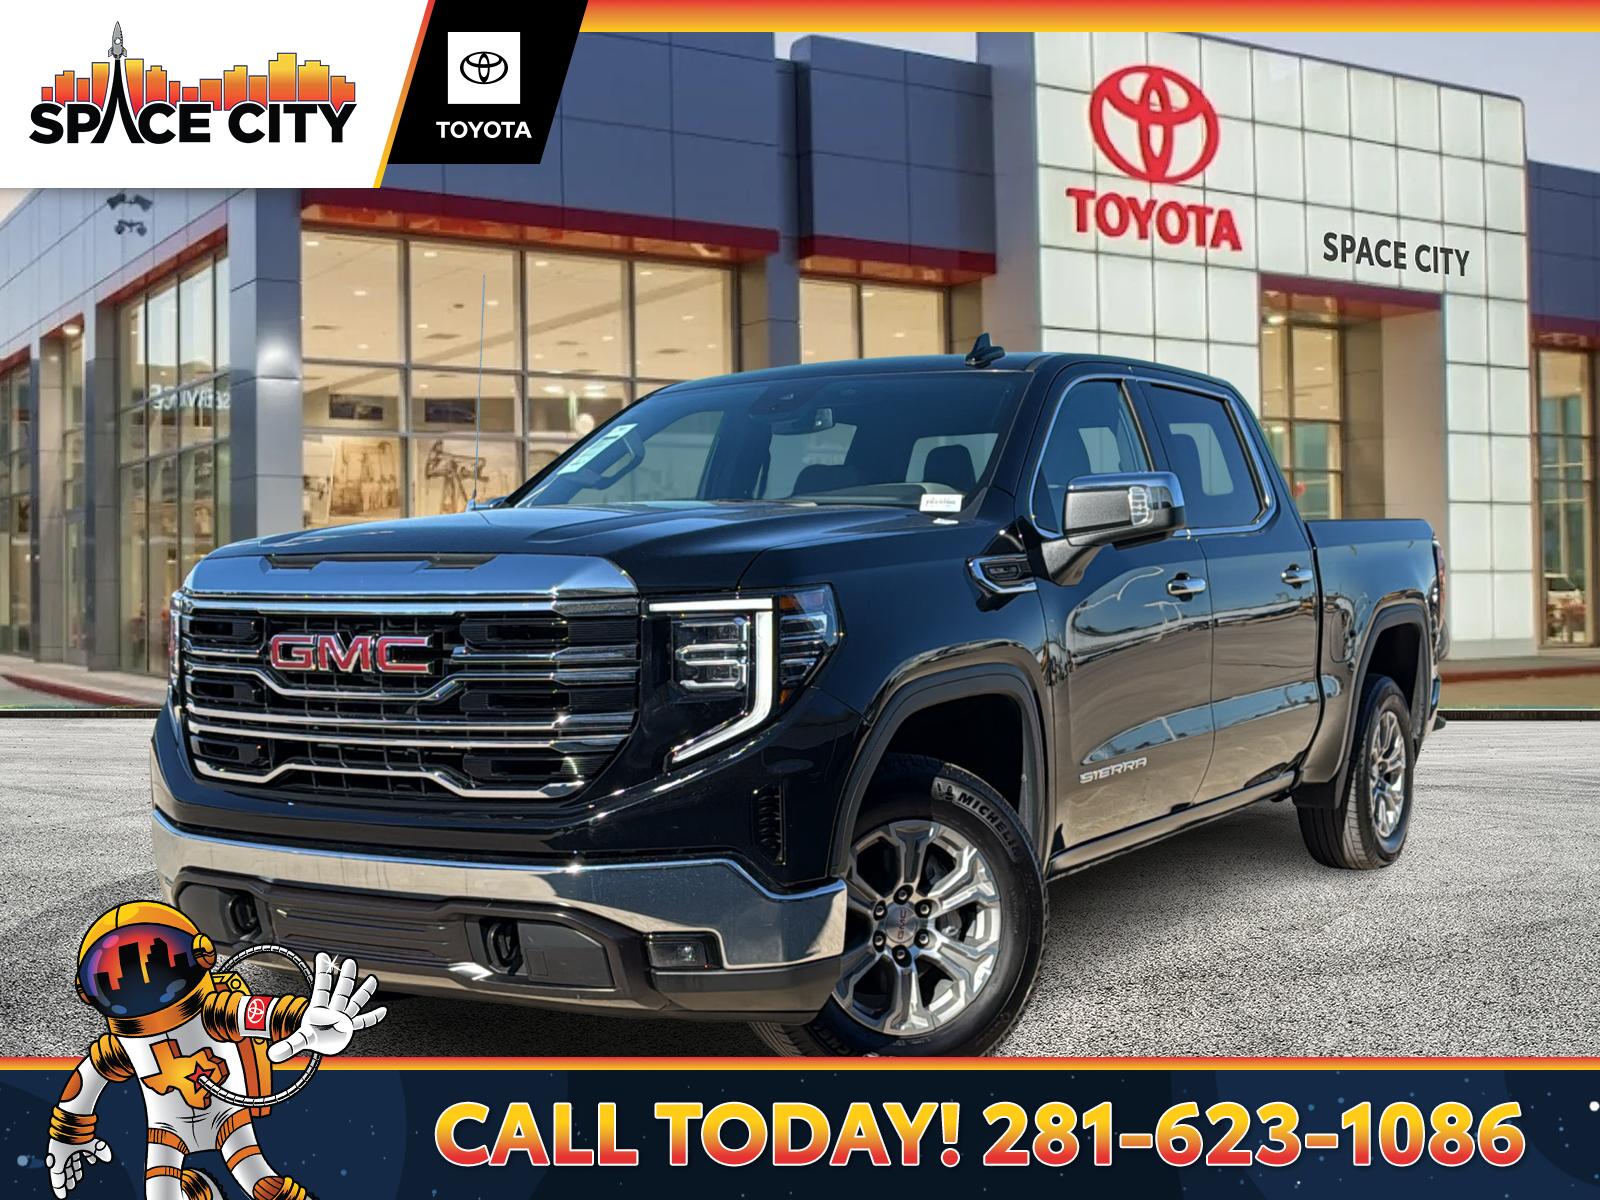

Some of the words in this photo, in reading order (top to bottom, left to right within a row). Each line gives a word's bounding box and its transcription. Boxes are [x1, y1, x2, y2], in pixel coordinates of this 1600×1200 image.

[1066, 188, 1242, 251] TOYOTA
[1323, 232, 1407, 270] SPACE
[1414, 244, 1470, 277] CITY
[270, 634, 433, 674] GMC
[1079, 757, 1148, 784] SIERRA
